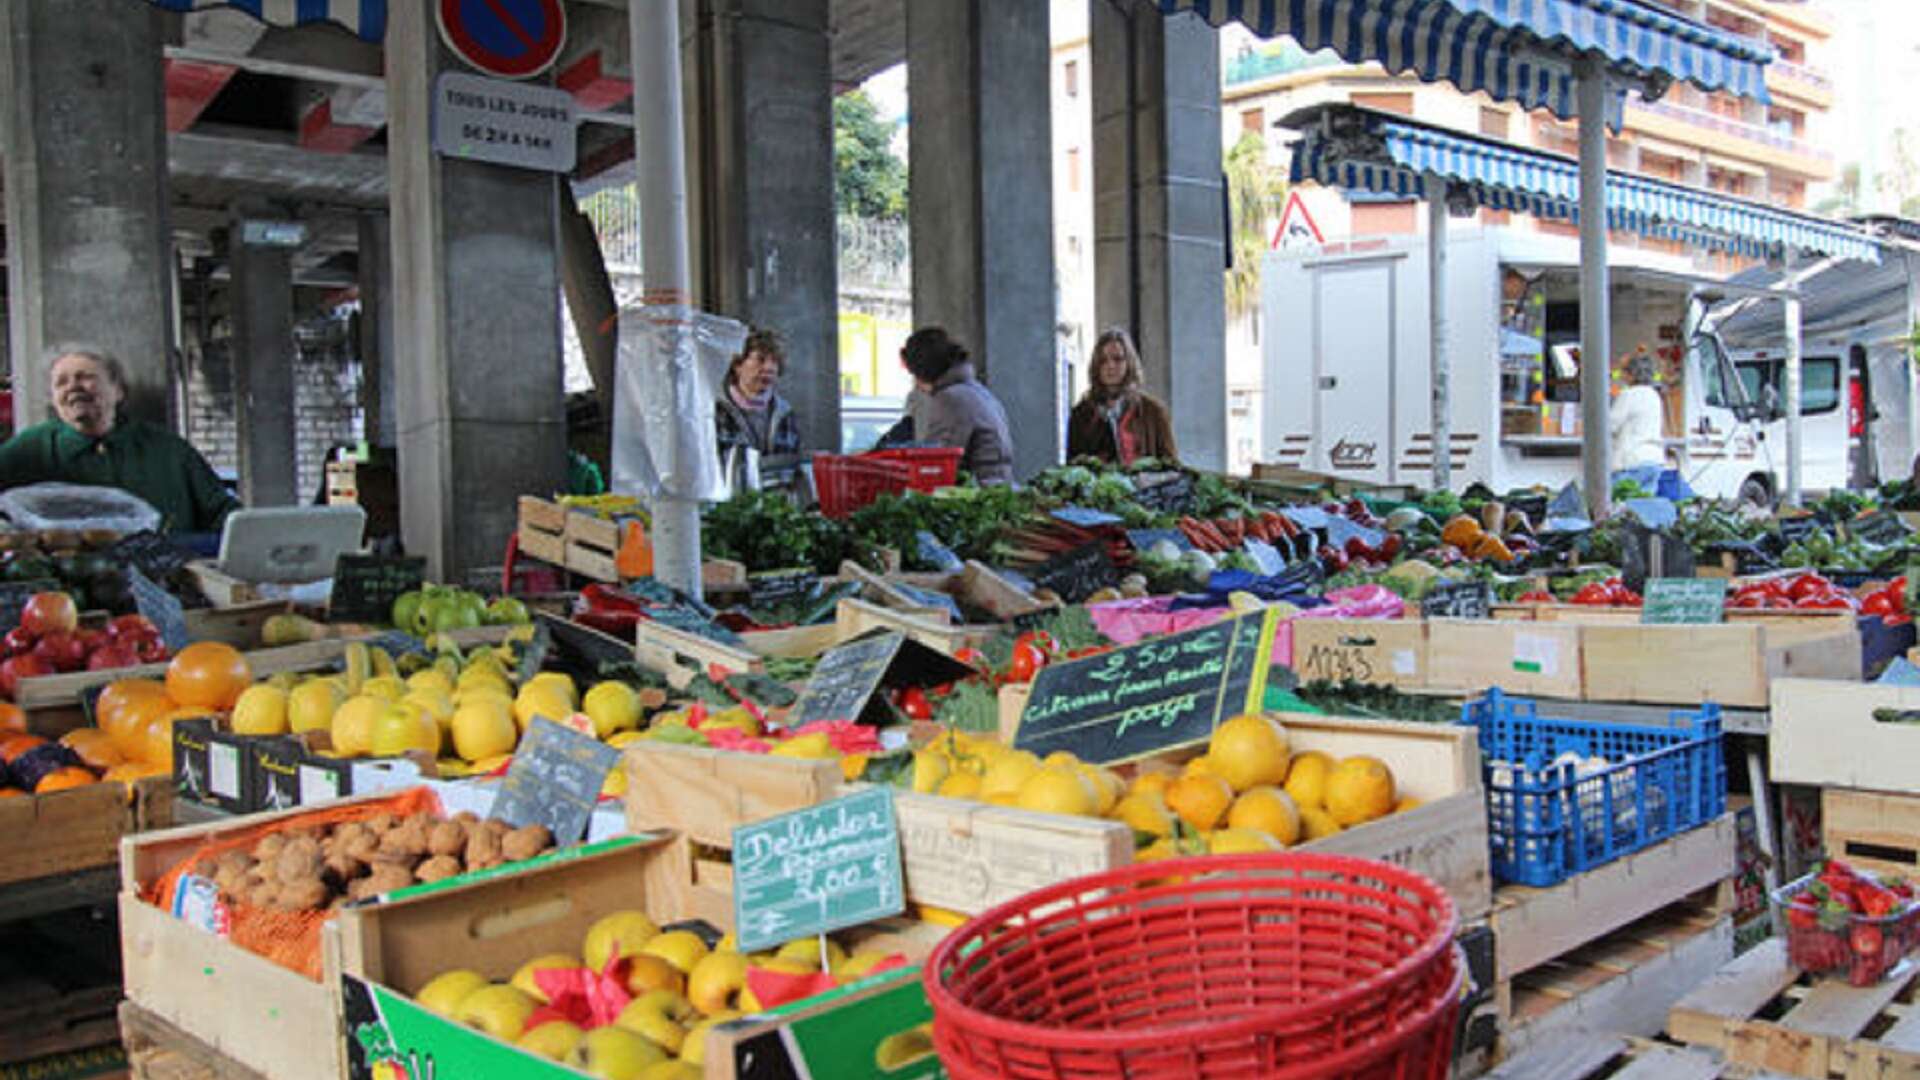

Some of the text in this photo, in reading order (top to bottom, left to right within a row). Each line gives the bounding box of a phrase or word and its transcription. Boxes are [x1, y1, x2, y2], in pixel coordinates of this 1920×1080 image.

[447, 90, 567, 122] TOUS LES JOURS
